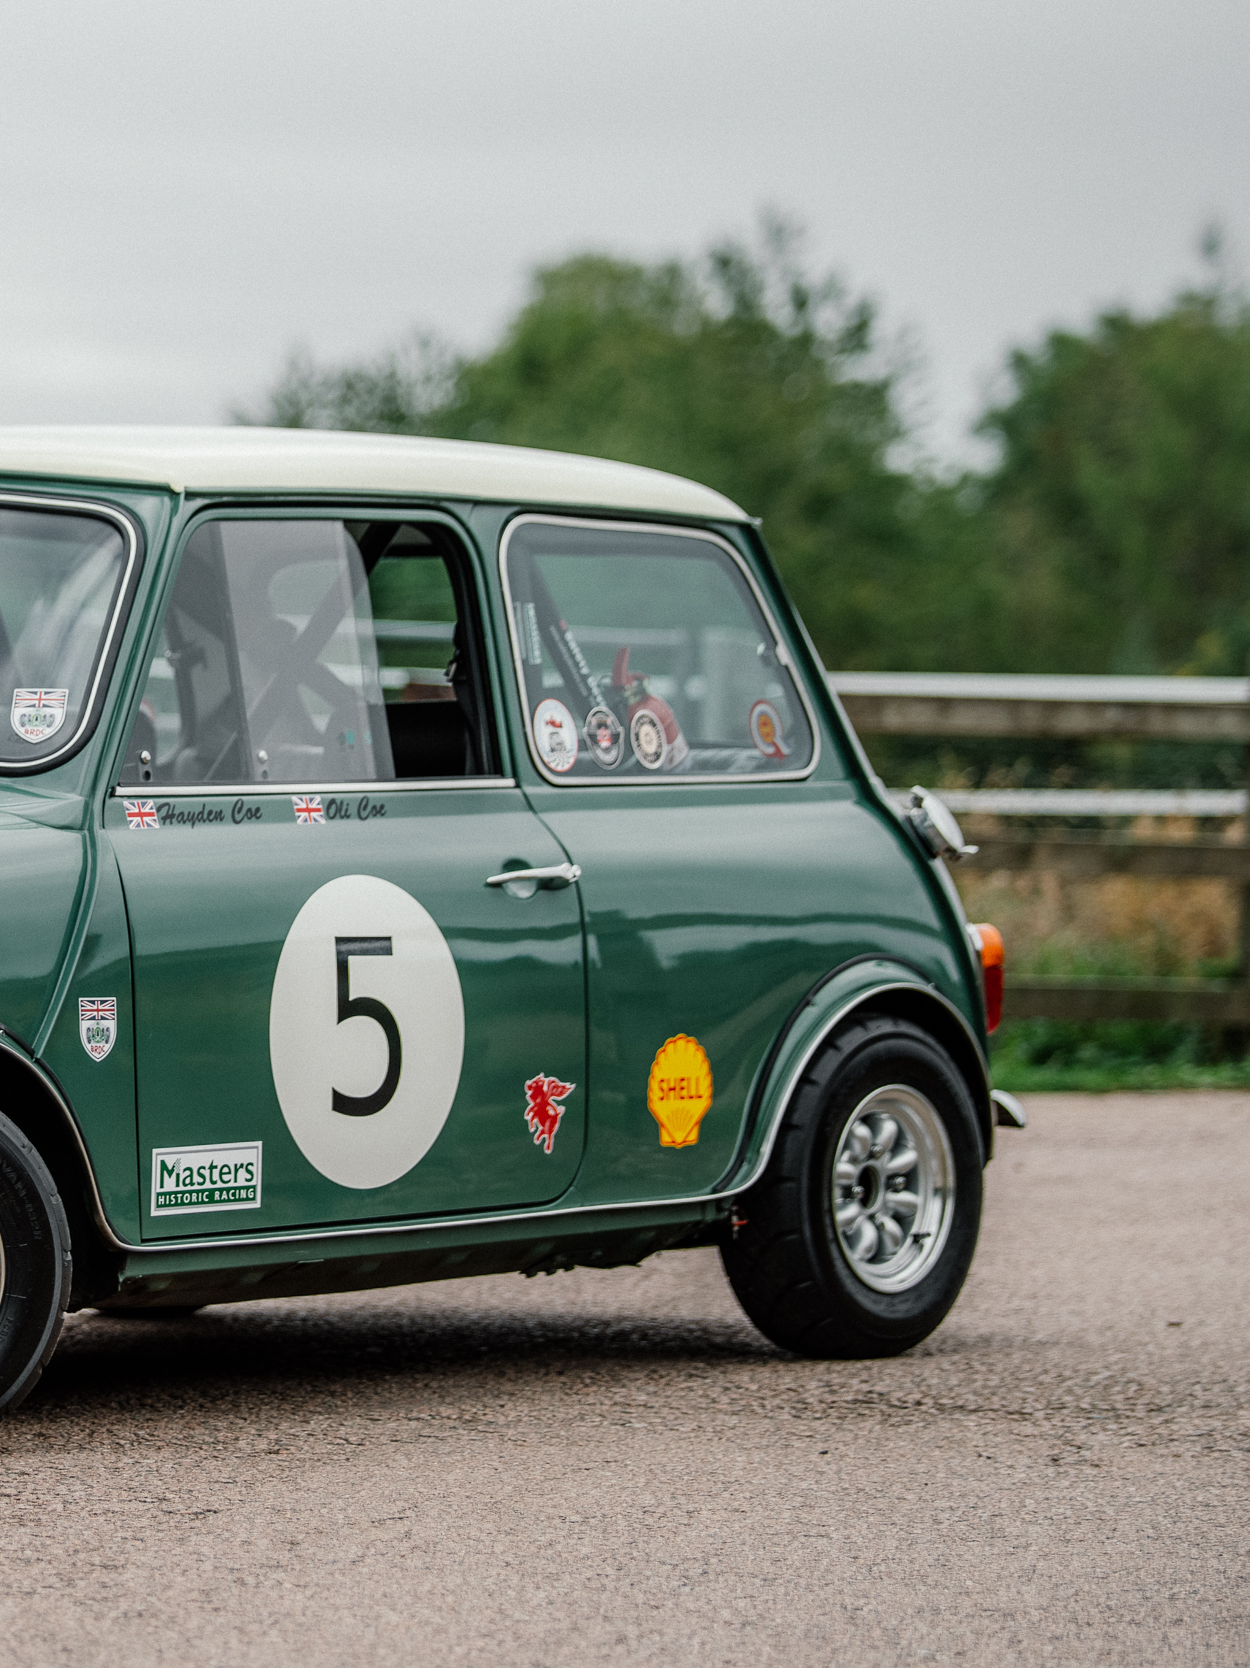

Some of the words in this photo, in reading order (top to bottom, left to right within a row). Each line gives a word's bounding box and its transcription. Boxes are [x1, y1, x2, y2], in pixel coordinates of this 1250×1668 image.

[24, 728, 46, 737] BRDC
[156, 802, 225, 829] Hayden
[231, 798, 263, 825] Coe
[326, 798, 352, 820] Oli
[357, 796, 388, 821] Coe
[332, 936, 403, 1117] 5
[658, 1077, 703, 1101] SHELL
[159, 1158, 255, 1189] Masters
[158, 1192, 210, 1205] HISTORIC
[214, 1188, 255, 1201] RACING
